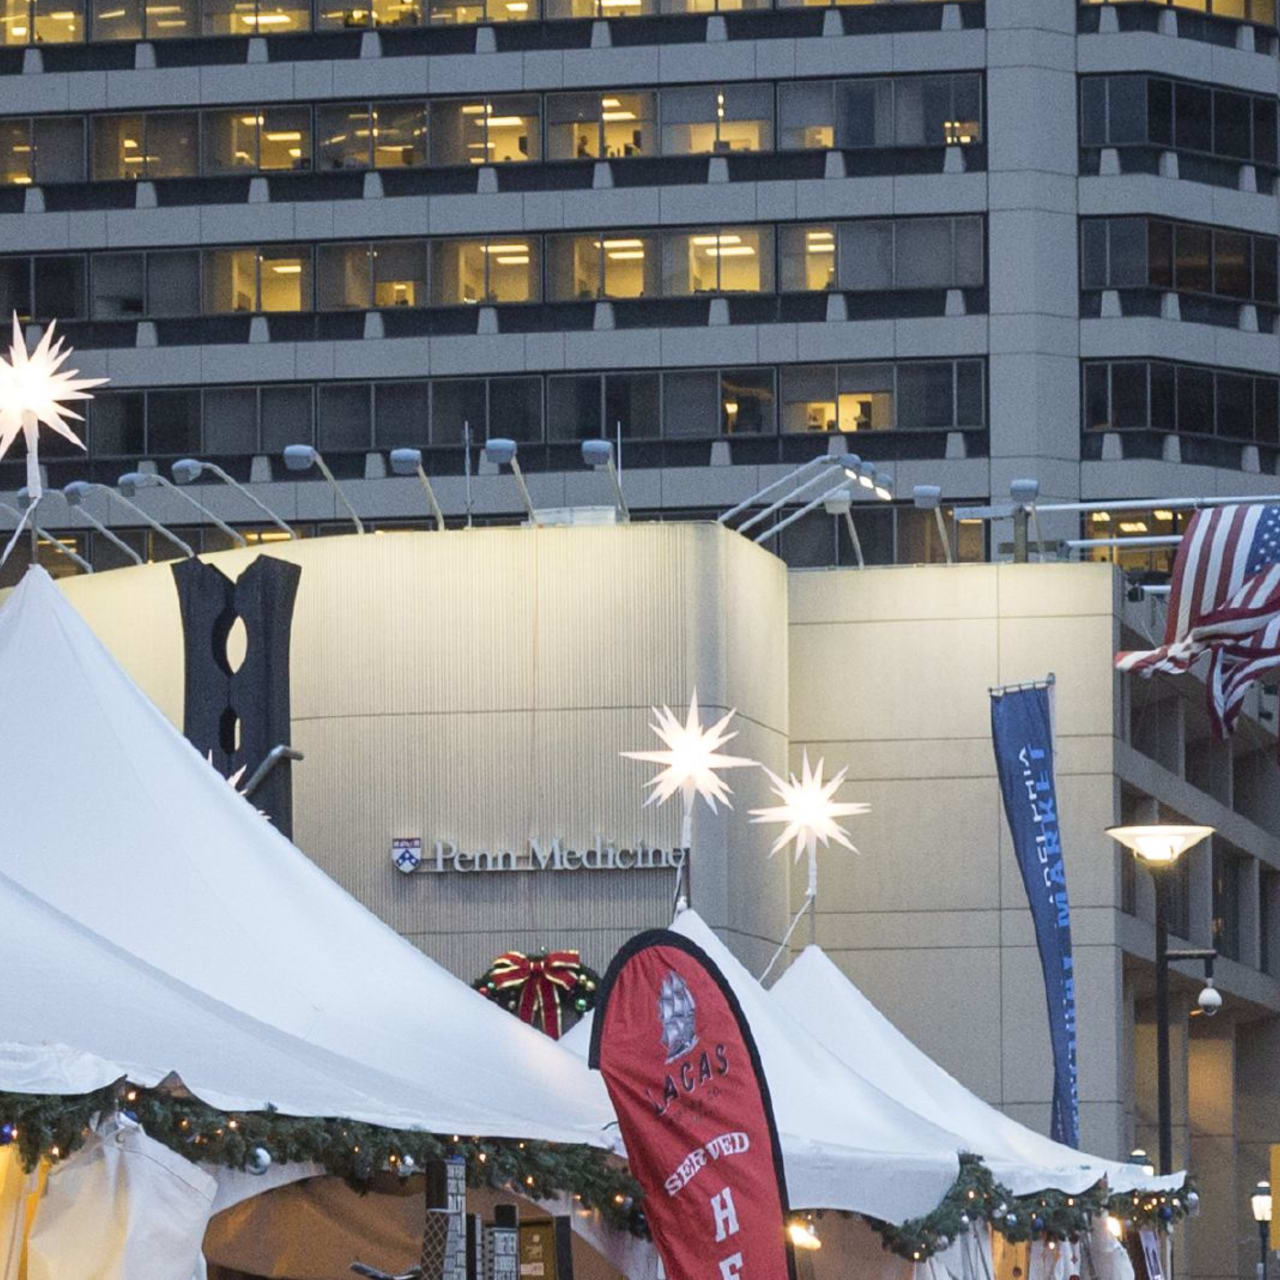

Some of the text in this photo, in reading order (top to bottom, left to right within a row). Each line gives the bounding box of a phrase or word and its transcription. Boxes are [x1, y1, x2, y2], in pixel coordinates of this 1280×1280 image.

[434, 835, 686, 872] Penn Medicine
[663, 1131, 751, 1197] SERVED
